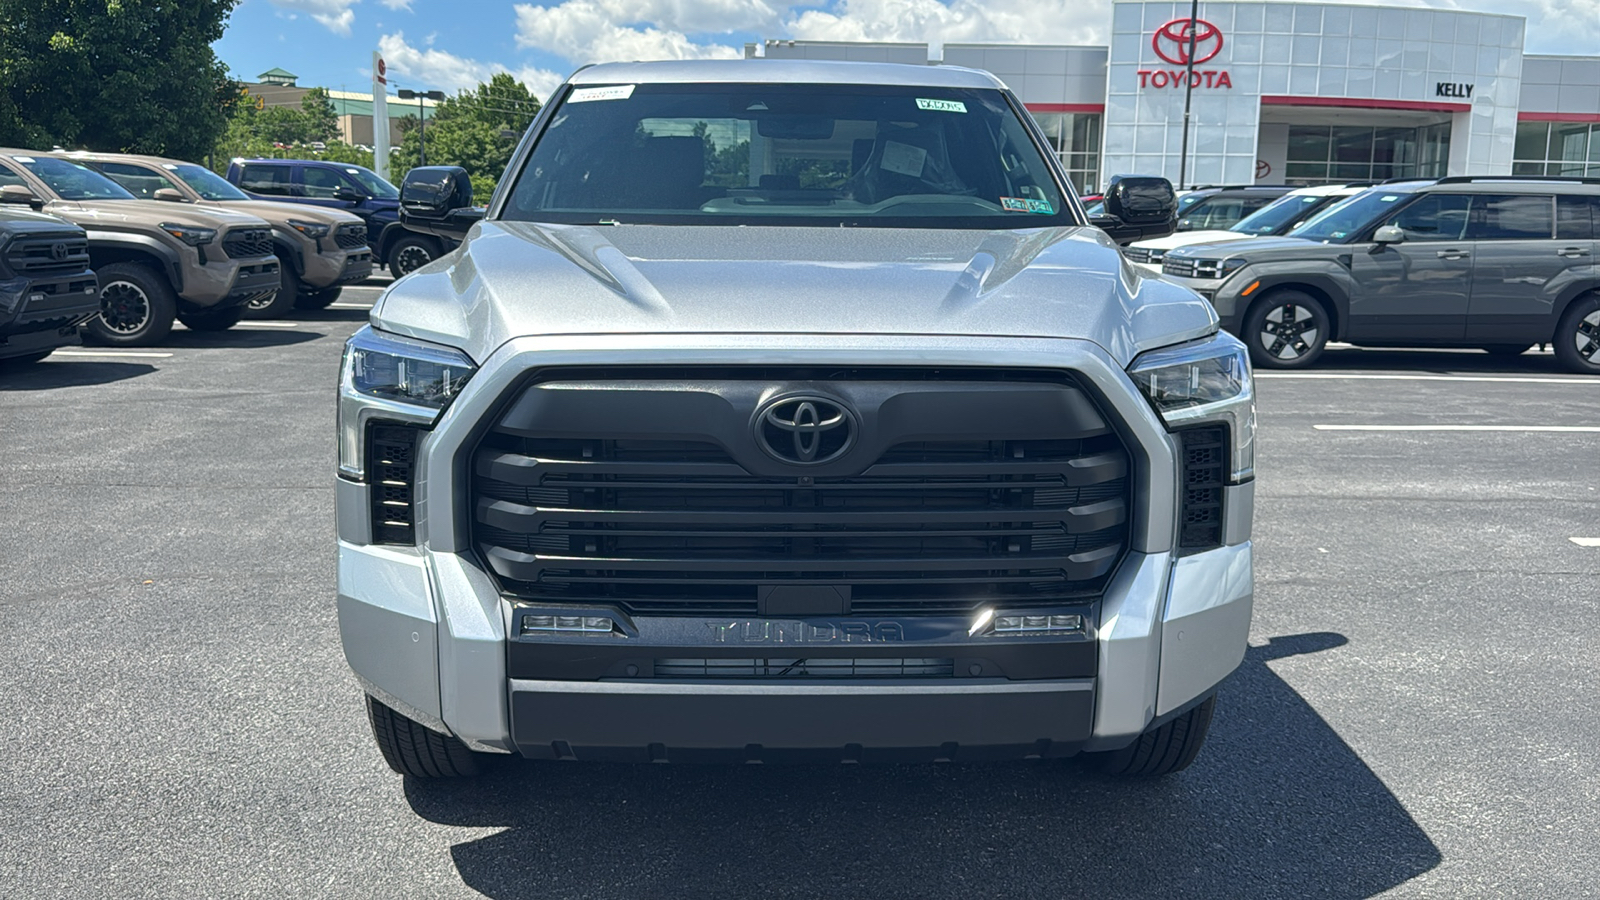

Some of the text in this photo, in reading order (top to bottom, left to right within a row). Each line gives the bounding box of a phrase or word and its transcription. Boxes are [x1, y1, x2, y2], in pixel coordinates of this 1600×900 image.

[1137, 69, 1232, 88] TOYOTA
[1436, 82, 1474, 98] KELLY
[705, 621, 905, 642] TUNDRA
